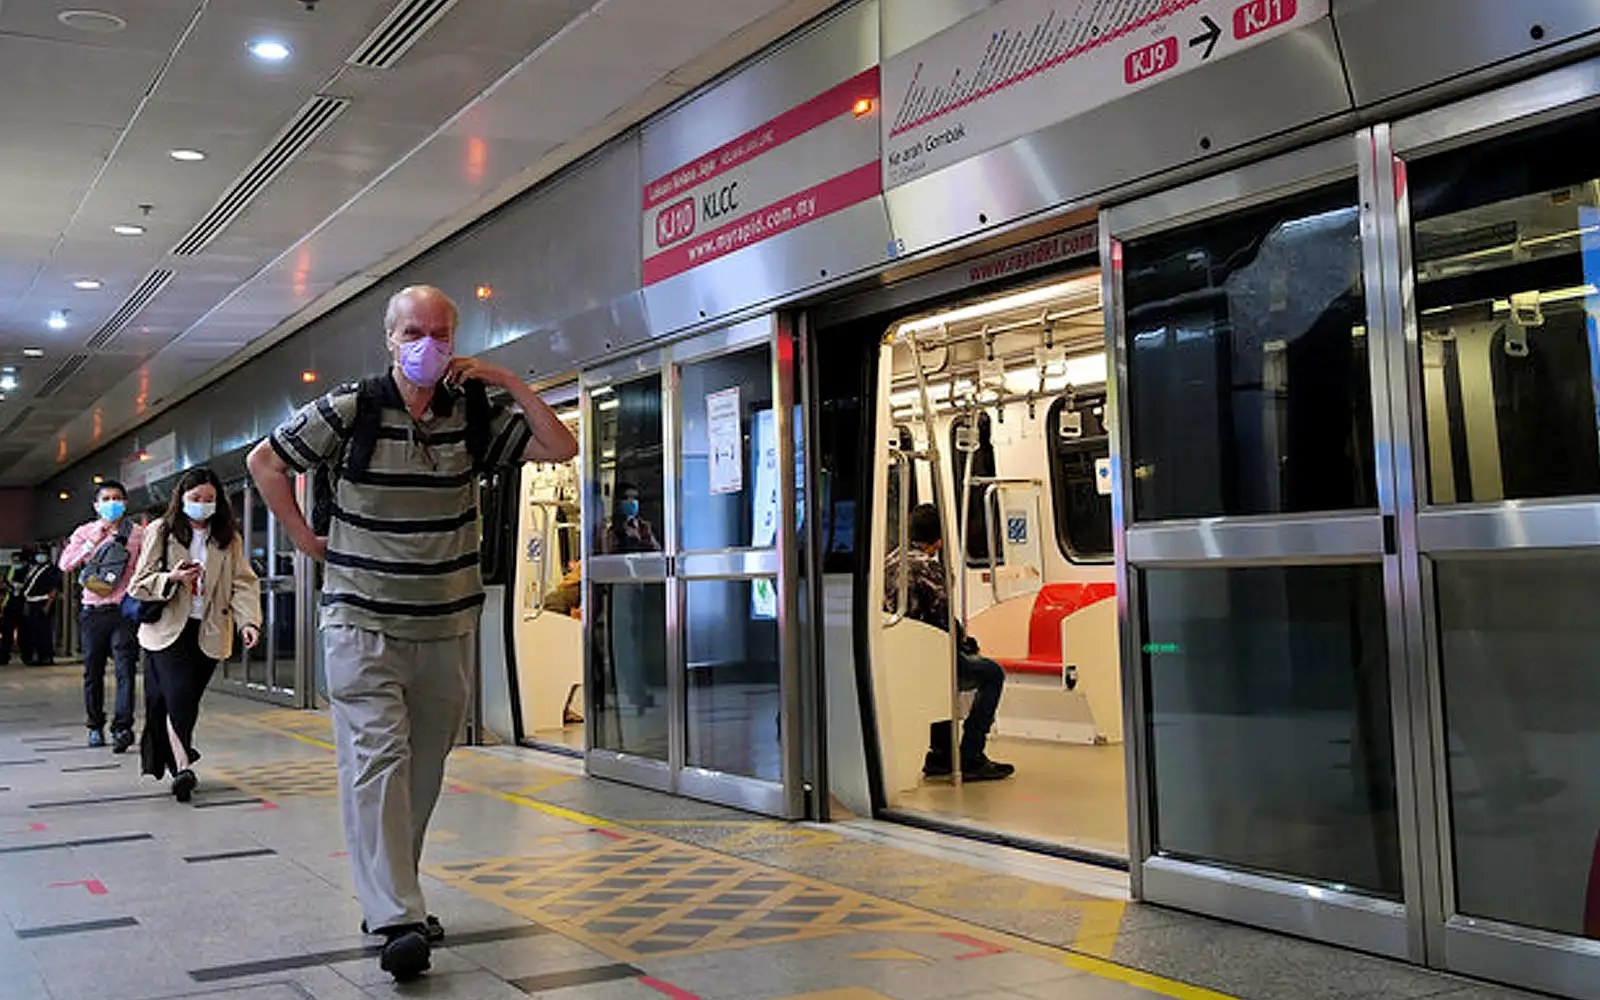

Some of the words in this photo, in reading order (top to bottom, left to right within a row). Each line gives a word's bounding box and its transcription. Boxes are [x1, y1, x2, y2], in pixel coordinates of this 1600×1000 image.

[1131, 44, 1167, 80] KJ9
[1243, 0, 1283, 33] KJ1
[925, 123, 966, 153] Gombak
[657, 202, 694, 245] KJ10
[701, 181, 739, 222] KLCC
[688, 196, 817, 262] www.myrapid.com.my
